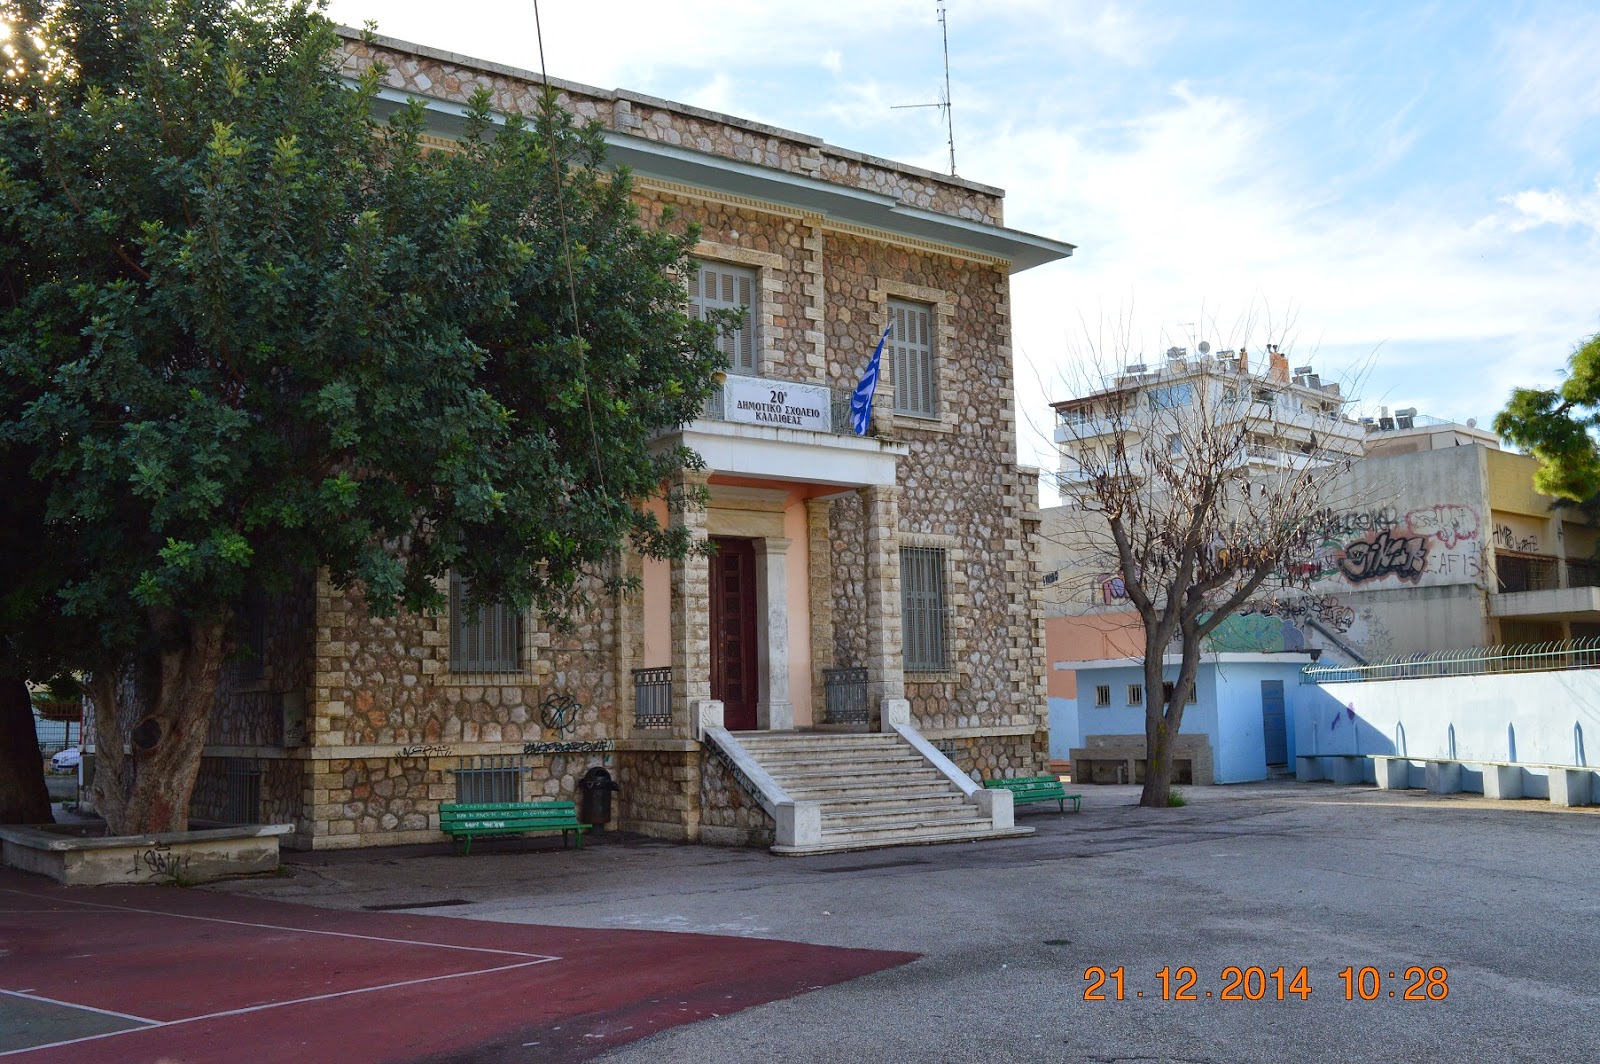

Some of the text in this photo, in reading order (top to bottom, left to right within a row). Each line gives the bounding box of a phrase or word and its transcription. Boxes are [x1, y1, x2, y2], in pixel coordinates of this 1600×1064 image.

[737, 400, 820, 418] ΔΗΜΟΤΙΚΟ ΣΧΟΛΕΙΟ
[755, 411, 803, 425] ΚΑΛΛΙΘΕΑΣ
